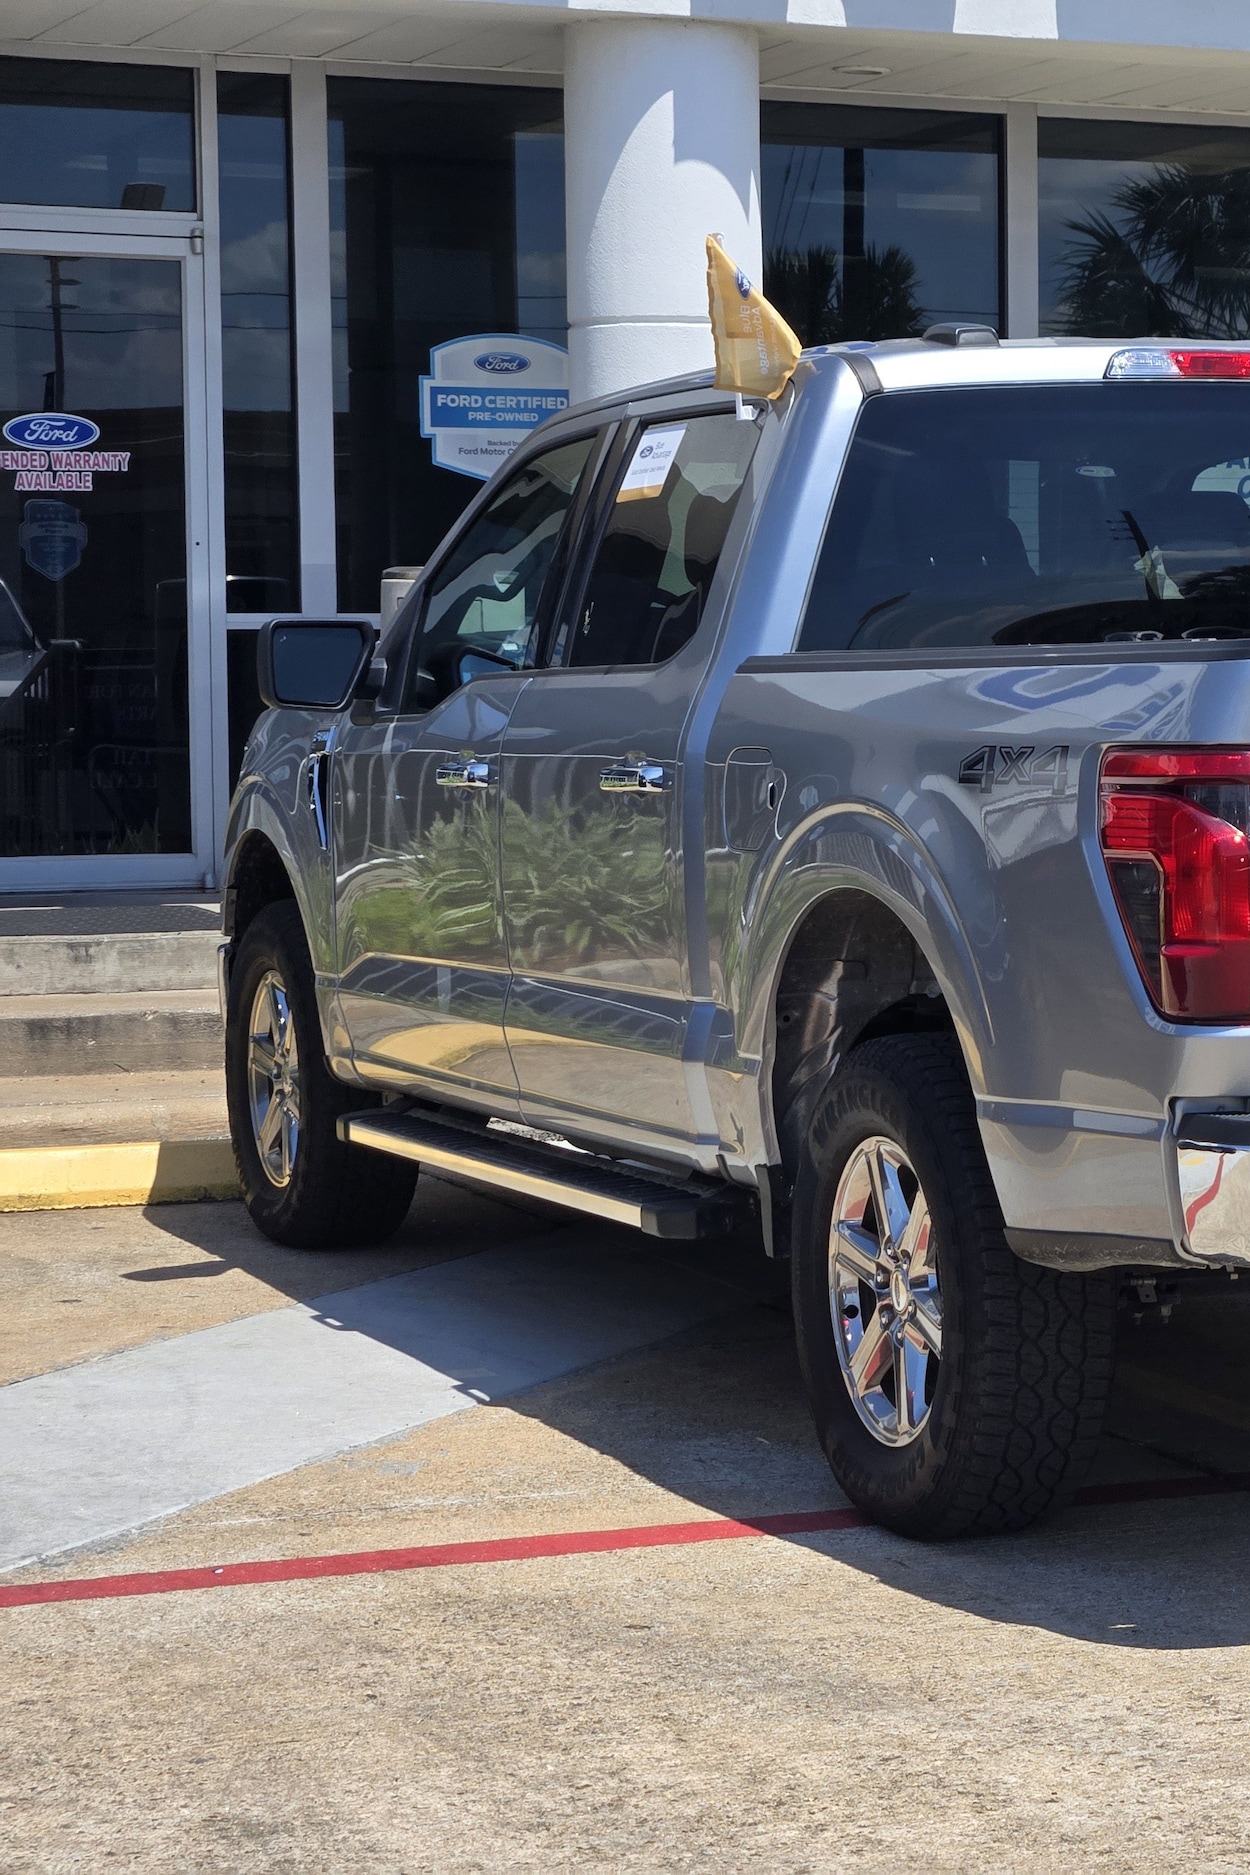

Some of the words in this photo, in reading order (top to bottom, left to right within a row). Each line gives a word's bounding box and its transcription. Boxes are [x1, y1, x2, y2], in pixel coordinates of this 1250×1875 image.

[485, 355, 519, 371] Ford
[437, 394, 482, 408] FORD
[484, 395, 568, 410] CERTIFIED
[468, 411, 539, 422] PRE-OWNED
[24, 419, 79, 442] Ford
[458, 447, 479, 455] Ford
[480, 448, 505, 456] Motor
[0, 452, 48, 469] ENDED
[53, 453, 129, 470] WARRANTY
[16, 473, 92, 489] AVAILABLE
